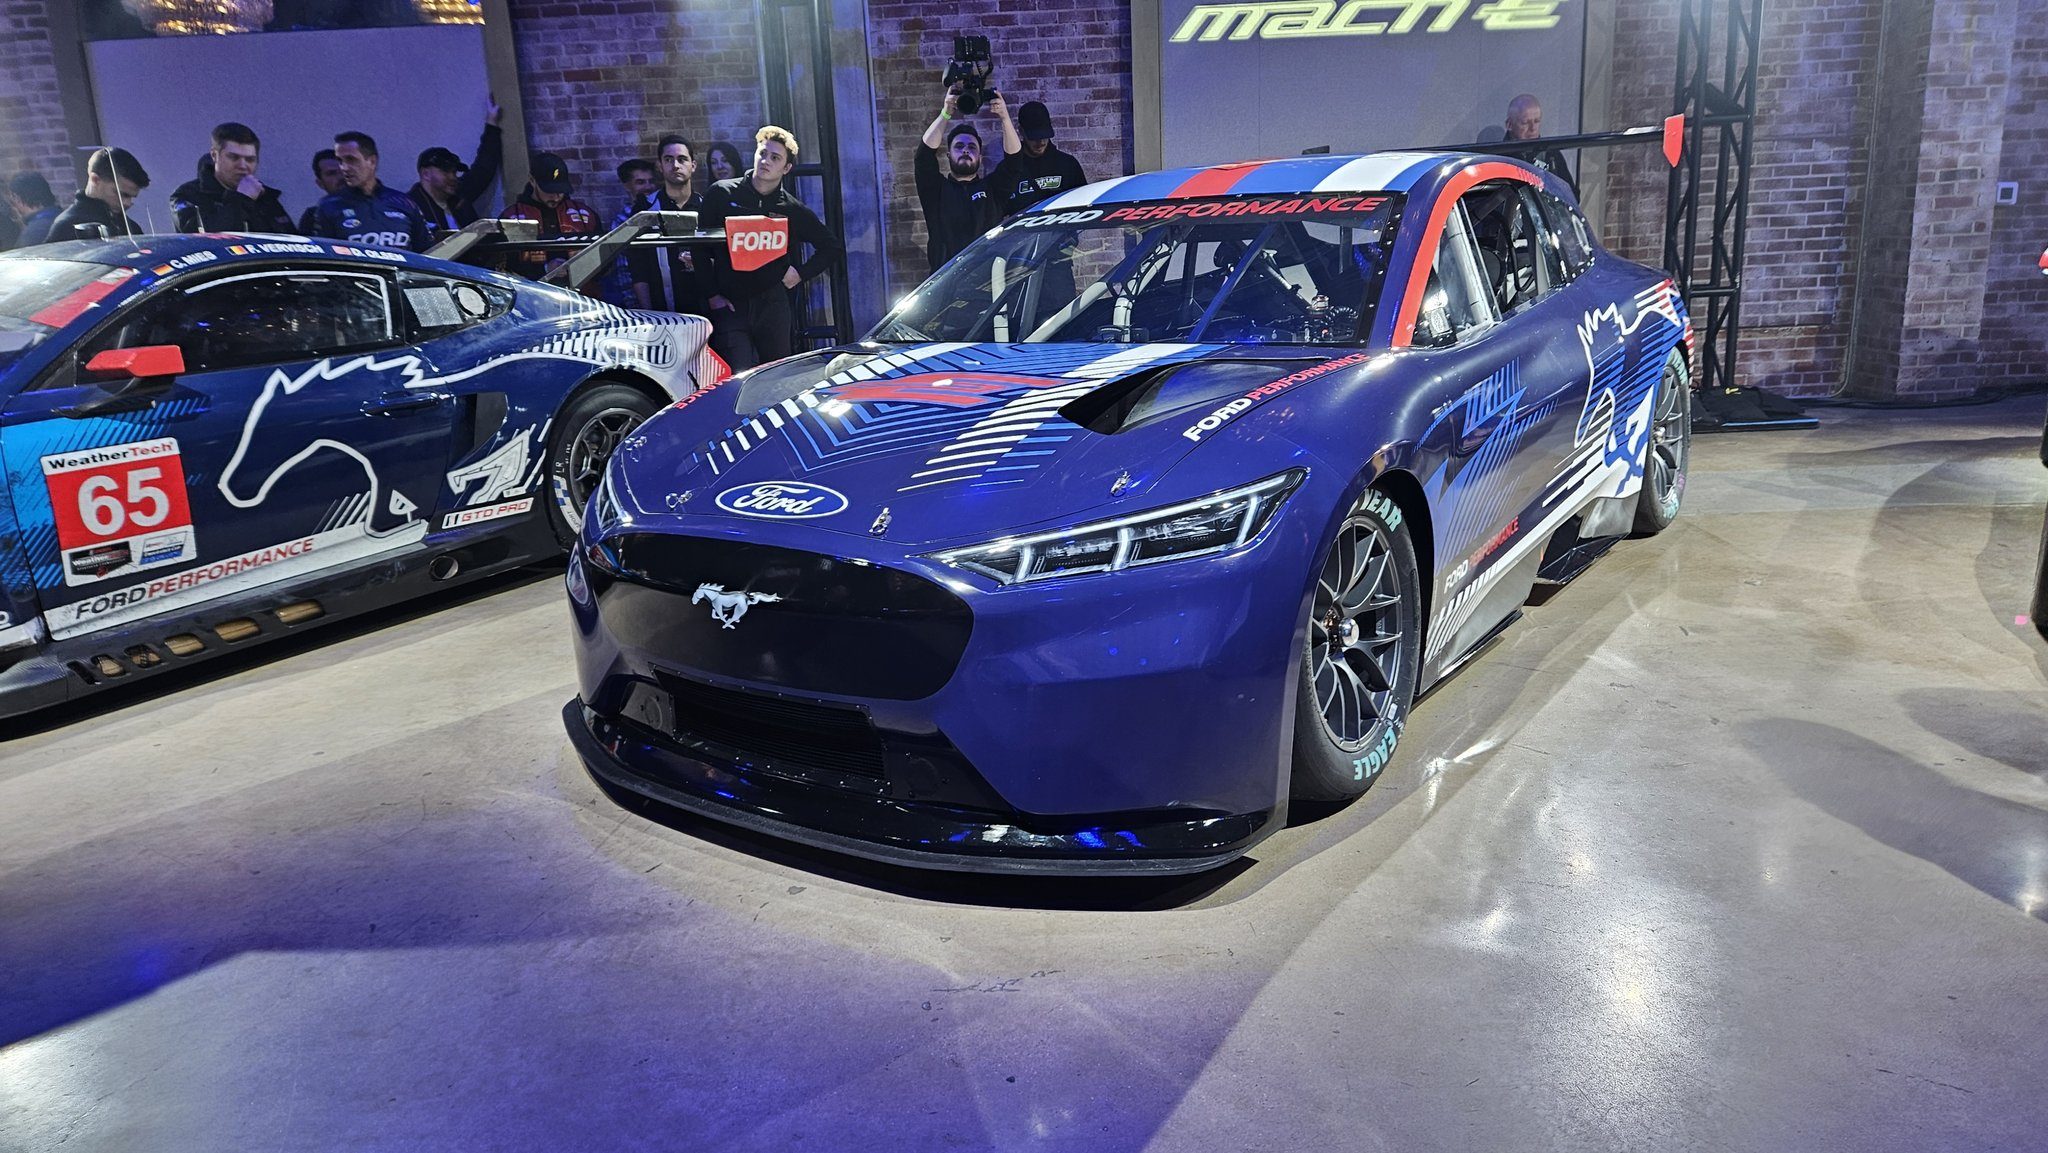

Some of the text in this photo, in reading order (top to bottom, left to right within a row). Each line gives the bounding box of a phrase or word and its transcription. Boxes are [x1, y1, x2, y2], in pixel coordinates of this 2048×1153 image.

[1004, 197, 1388, 230] FORD PERFORMANCE
[731, 230, 787, 252] FORD
[48, 443, 172, 470] WeatherTech
[77, 466, 169, 536] 65
[461, 501, 528, 522] GTD PRO
[733, 484, 825, 514] Ford
[1352, 727, 1397, 780] EAGLE
